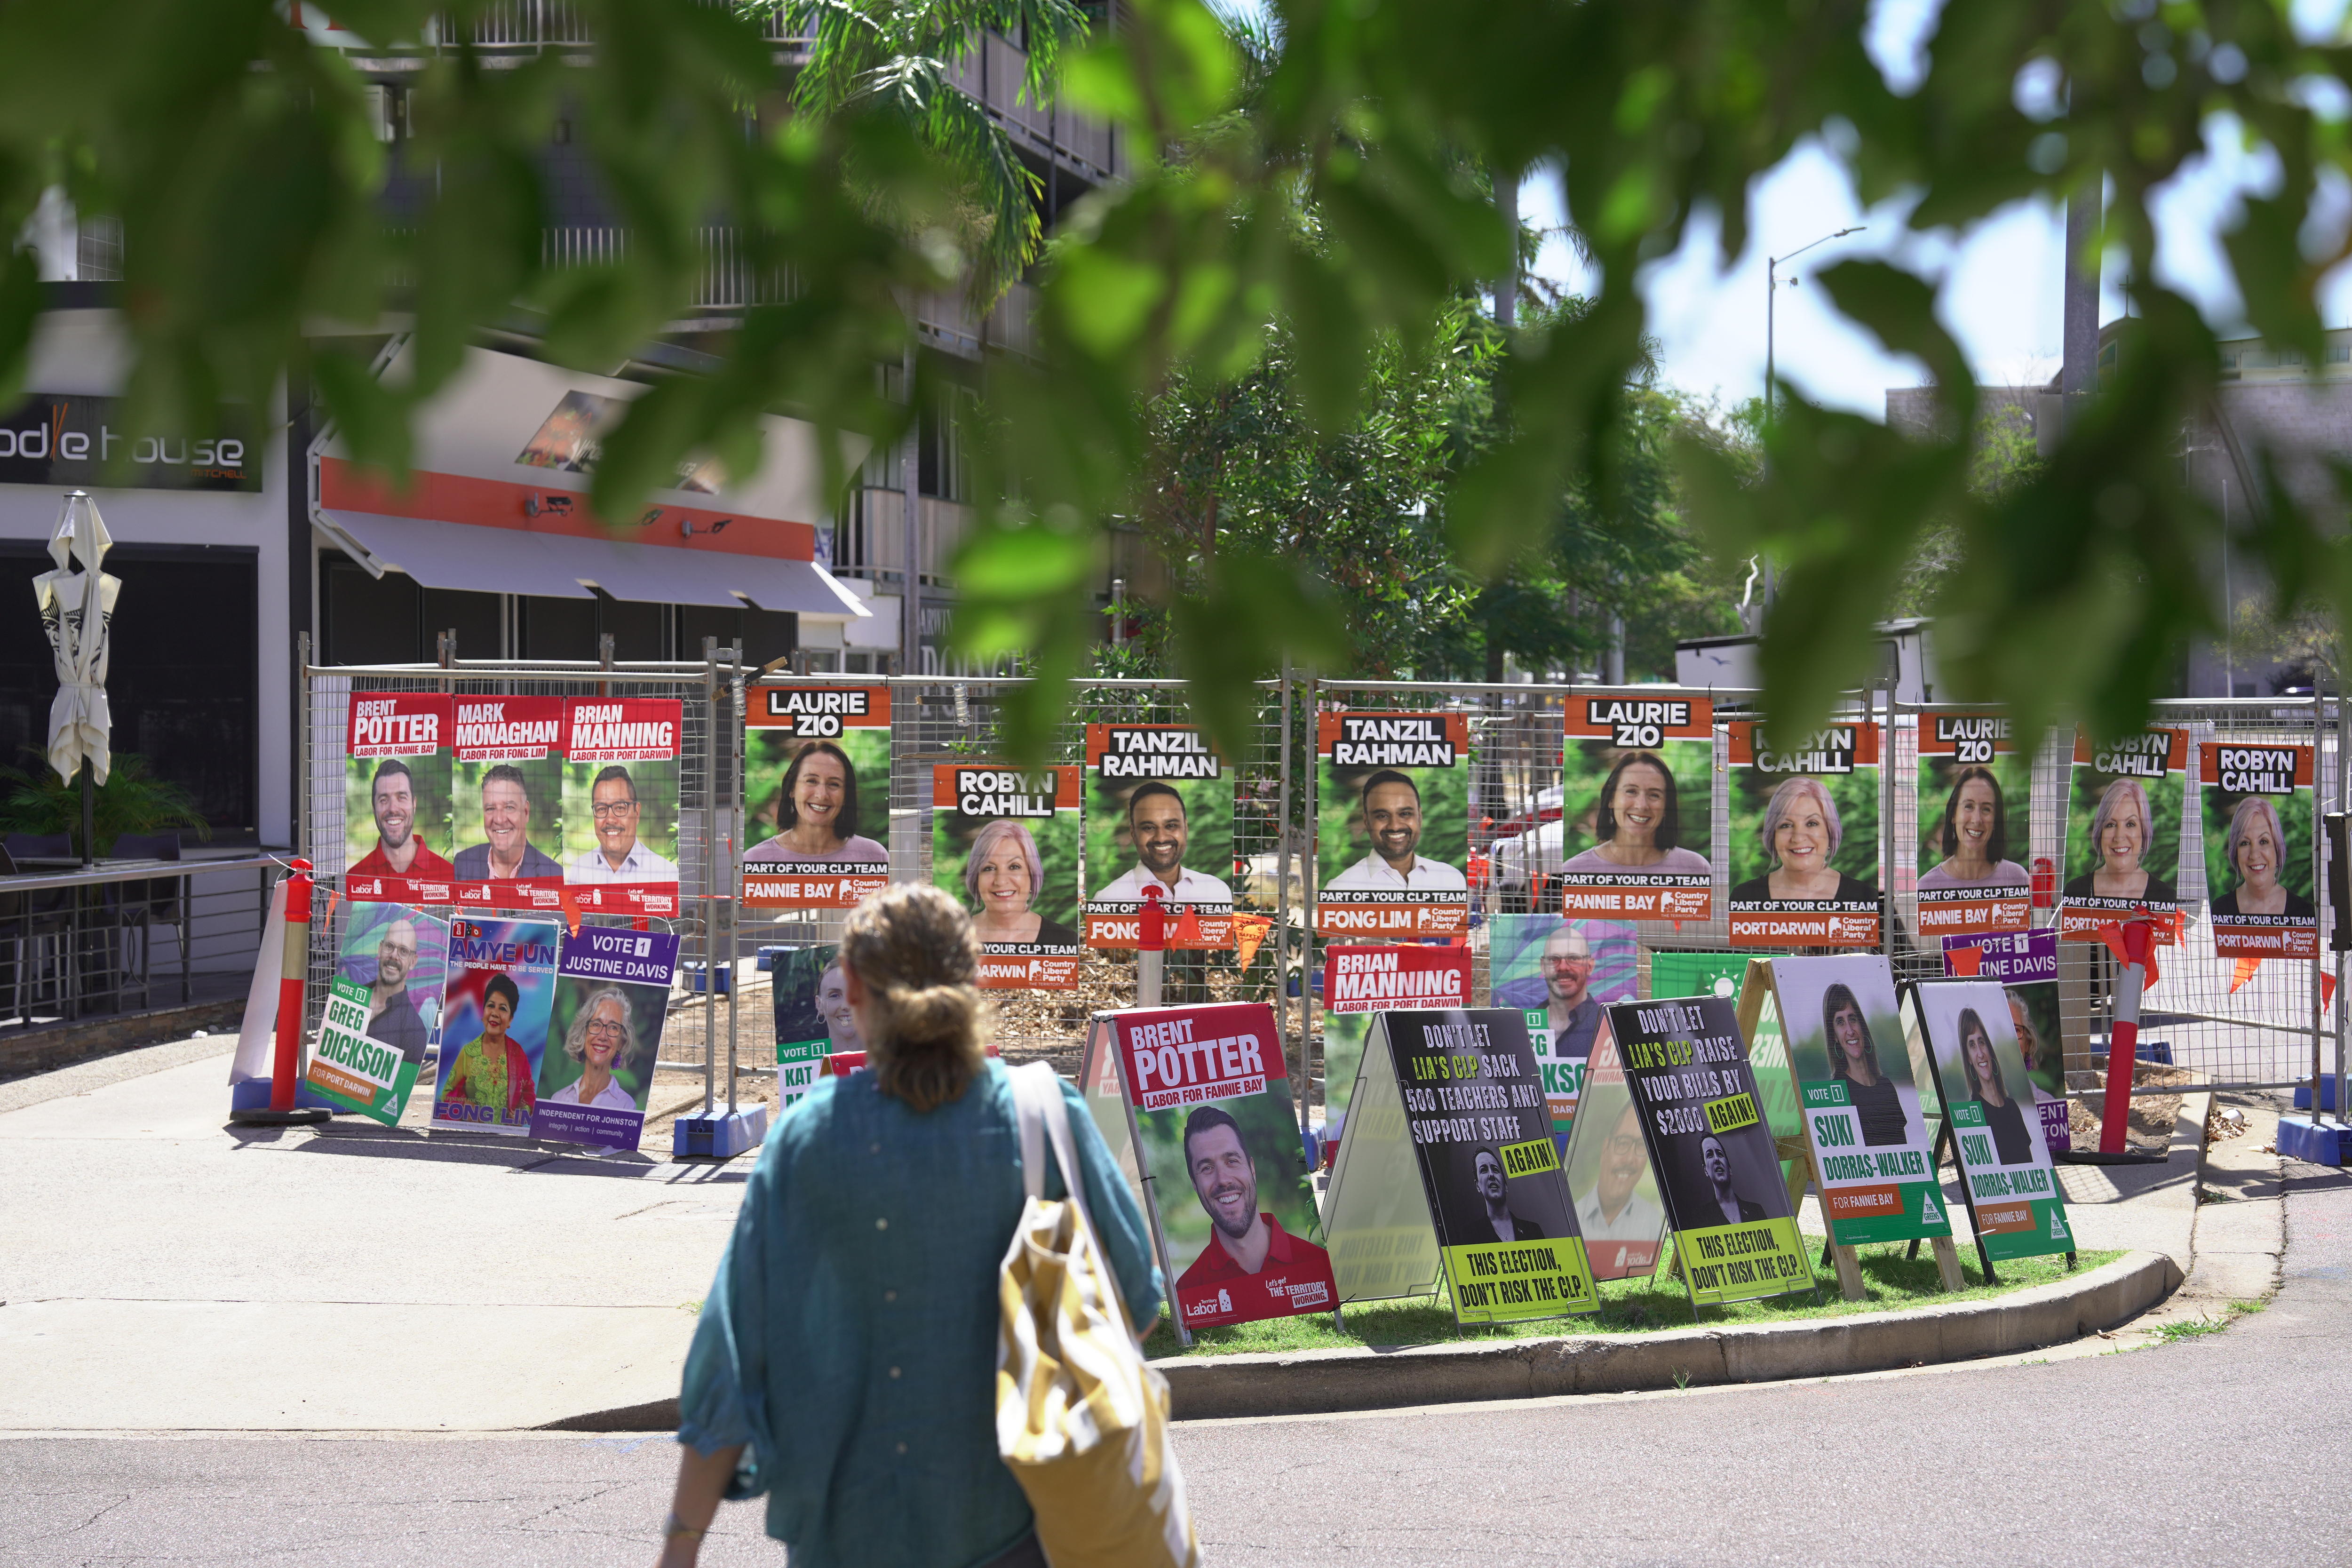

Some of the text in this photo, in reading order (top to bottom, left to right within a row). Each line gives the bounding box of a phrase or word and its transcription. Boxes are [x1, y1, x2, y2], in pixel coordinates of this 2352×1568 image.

[102, 425, 244, 467] house
[191, 469, 246, 479] MITCHELL
[357, 700, 397, 717] BRENT
[458, 703, 505, 724] MARK
[771, 693, 865, 713] LAURIE
[1591, 702, 1686, 724] LAURIE
[574, 705, 622, 724] BRIAN
[354, 714, 438, 744] POTTER
[456, 720, 558, 746] MONAGHAN
[571, 722, 673, 748] MANNING
[797, 715, 839, 736] ZIO
[1346, 720, 1441, 741] TANZIL
[1617, 725, 1660, 746] ZIO
[1939, 719, 2013, 739] LAURIE
[356, 745, 435, 756] LABOR FOR FANNIE BAY
[1113, 732, 1207, 753] TANZIL
[1959, 740, 1991, 762] ZIO
[461, 748, 546, 760] LABOR FOR FONG LIM
[572, 750, 671, 761] LABOR FOR PORT DARWIN
[1336, 743, 1451, 764] RAHMAN
[1757, 751, 1850, 772] CAHILL
[2221, 749, 2293, 771] ROBYN
[1104, 756, 1216, 776] RAHMAN
[2095, 753, 2163, 776] CAHILL
[960, 772, 1053, 793] ROBYN
[2222, 771, 2291, 793] CAHILL
[961, 794, 1051, 815] CAHILL
[745, 864, 888, 873] PART OF YOUR CLP TEAM
[351, 885, 372, 894] Labor
[746, 883, 834, 898] FANNIE BAY
[1565, 894, 1656, 910] FANNIE BAY
[1324, 911, 1411, 928] FONG LIM
[1732, 922, 1825, 935] PORT DARWIN
[593, 935, 634, 954] VOTE
[2217, 934, 2280, 948] PORT DARWIN
[450, 939, 555, 965] AMYE UN
[566, 956, 668, 979] JUSTINE DAVIS
[1337, 953, 1398, 974] BRIAN
[2014, 955, 2056, 974] DAVIS
[337, 982, 354, 996] VOTE
[1335, 969, 1461, 999] MANNING
[329, 1001, 365, 1032] GREG
[1637, 1005, 1705, 1034] DON'T LET
[1130, 1019, 1193, 1050] BRENT
[1423, 1024, 1491, 1048] DON'T LET
[318, 1027, 397, 1082] DICKSON
[783, 1047, 807, 1058] VOTE
[1134, 1034, 1264, 1090] POTTER
[1628, 1036, 1738, 1069] LIA'S CLP RAISE
[785, 1067, 812, 1087] KAT
[1412, 1054, 1521, 1080] LIA'S CLP SACK
[313, 1067, 326, 1078] FOR
[326, 1074, 344, 1086] PORT
[344, 1080, 370, 1098] DARWIN
[1146, 1078, 1263, 1108] LABOR FOR FANNIE BAY
[1641, 1069, 1742, 1102] YOUR BILLS BY
[1406, 1085, 1540, 1112] 500 TEACHERS AND
[1807, 1089, 1829, 1100] VOTE
[434, 1102, 494, 1123] FONG
[539, 1108, 585, 1120] INDEPENDENT
[602, 1116, 638, 1127] JOHNSTON
[1656, 1097, 1755, 1136] $2000 AGAIN!
[1954, 1109, 1970, 1120] VOTE
[549, 1122, 568, 1131] integrity
[596, 1129, 624, 1138] community
[1412, 1116, 1521, 1144] SUPPORT STAFF
[1814, 1114, 1855, 1147] SUKI
[1505, 1142, 1556, 1174] AGAIN!
[1962, 1134, 1993, 1166] SUKI
[1823, 1151, 1925, 1180] DORRAS-WALKER
[1971, 1169, 2050, 1198] DORRAS-WALKER
[1833, 1194, 1893, 1209] FOR FANNIE BAY
[1982, 1210, 2027, 1225] FOR FANNIE BAY
[1467, 1248, 1561, 1276] THIS ELECTION,
[1266, 1276, 1287, 1289] Let's get
[1269, 1281, 1326, 1297] THE TERRITORY
[1459, 1282, 1499, 1307] DON'T
[1500, 1279, 1533, 1304] RISK
[1532, 1277, 1557, 1300] THE
[1294, 1292, 1327, 1305] WORKING.
[1186, 1303, 1217, 1316] Labor
